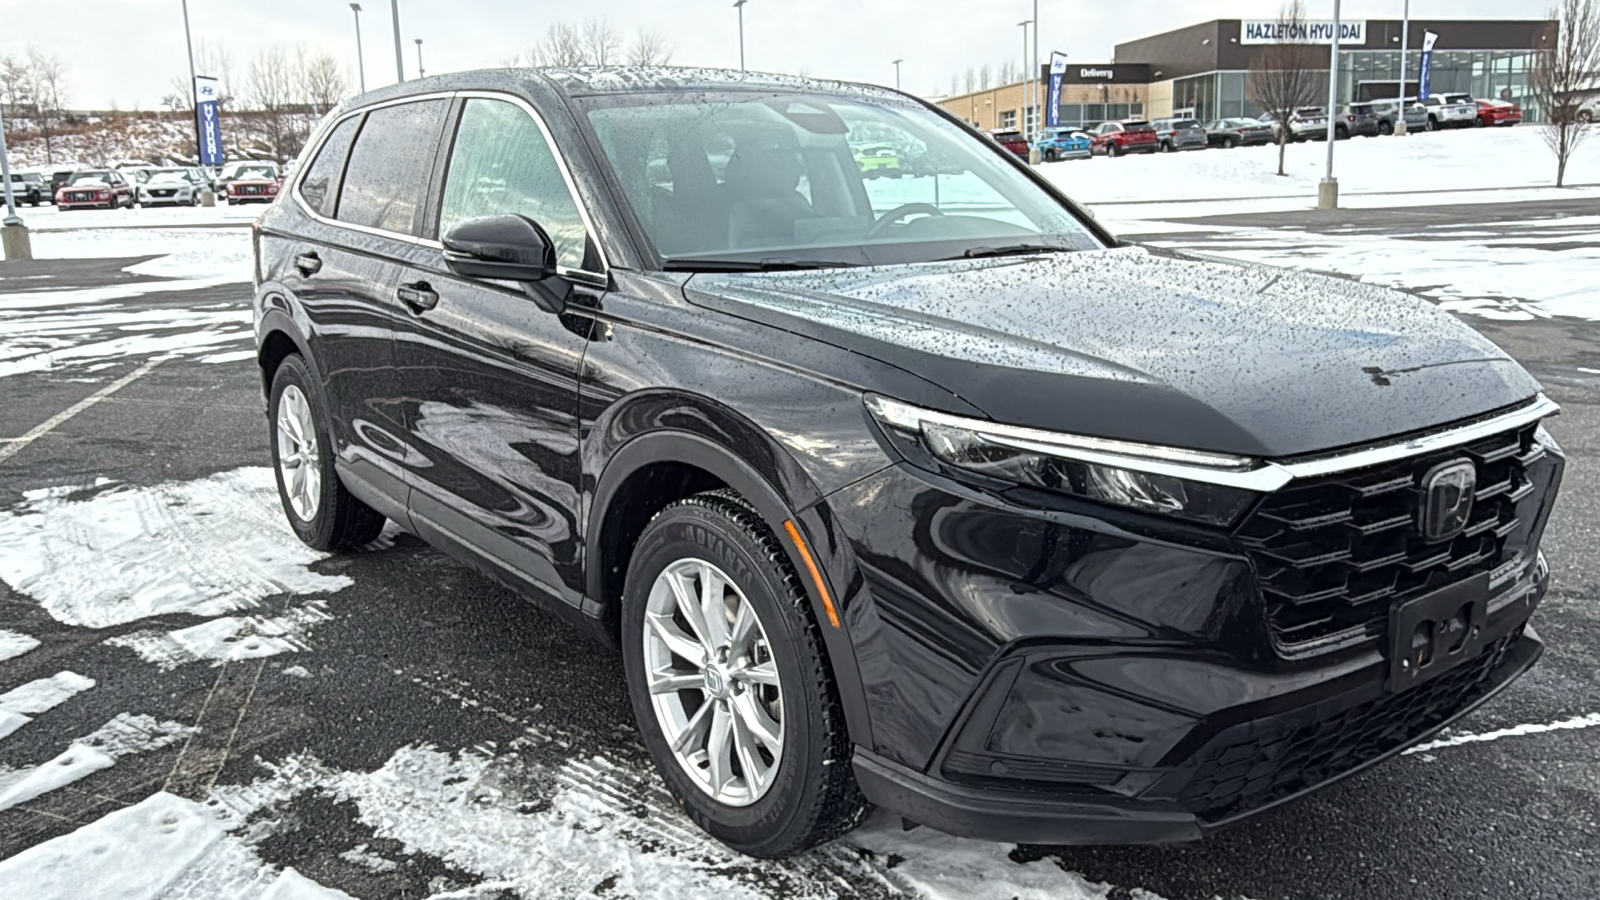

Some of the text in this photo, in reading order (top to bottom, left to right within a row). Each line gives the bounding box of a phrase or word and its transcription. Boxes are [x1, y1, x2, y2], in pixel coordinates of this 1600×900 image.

[1246, 23, 1361, 39] HAZLETON HYUDAI
[1080, 68, 1113, 79] Delivery
[203, 103, 217, 163] HYUNDAI
